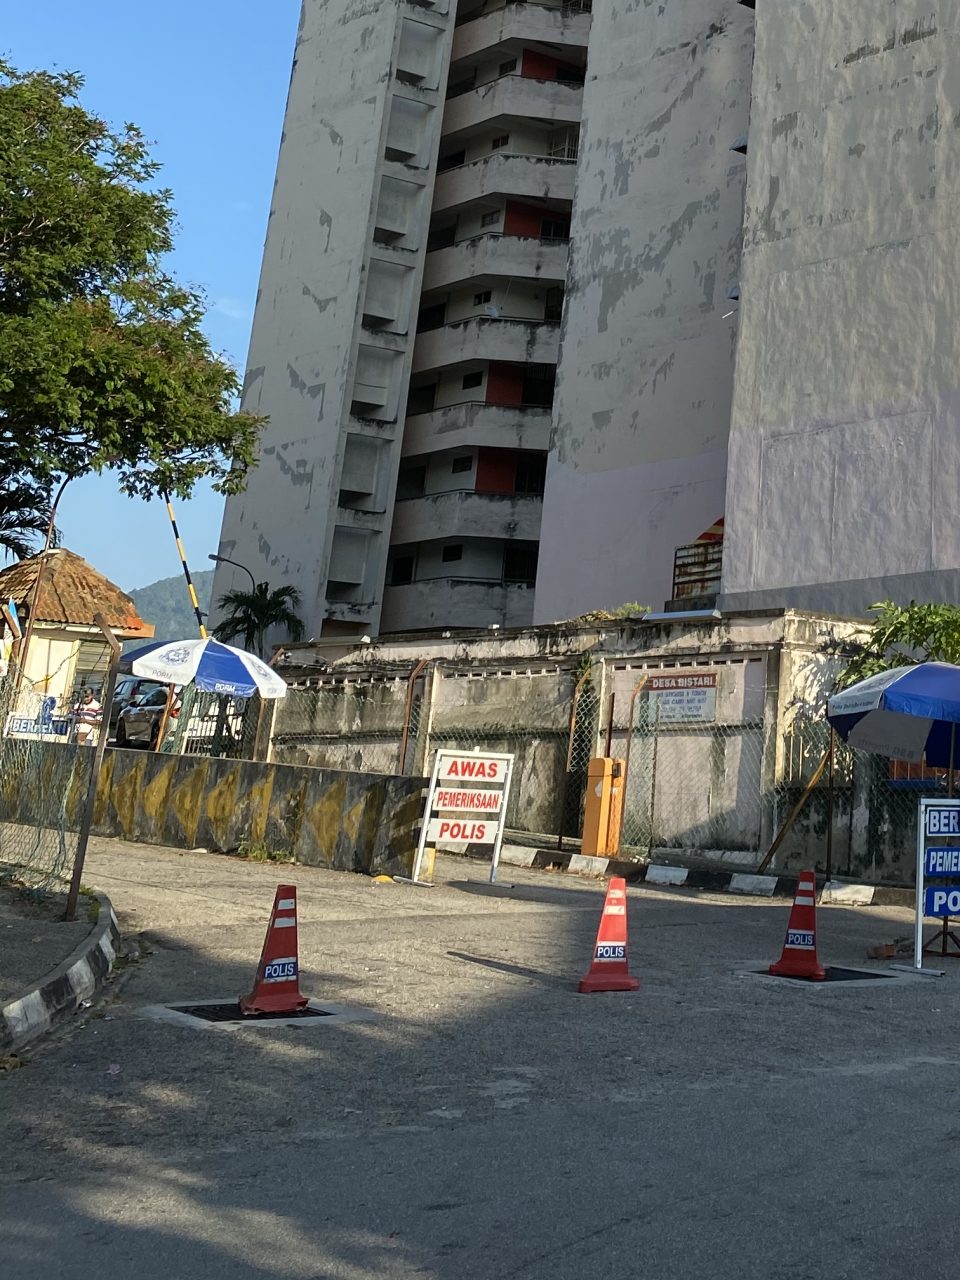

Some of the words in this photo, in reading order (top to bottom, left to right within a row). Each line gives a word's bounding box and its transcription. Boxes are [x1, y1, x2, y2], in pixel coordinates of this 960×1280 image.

[652, 678, 676, 688] DESA
[677, 676, 713, 687] BISTARI
[447, 760, 498, 778] AWAS
[437, 791, 500, 809] PEMERIKSAAN
[439, 822, 486, 839] POLIS
[788, 934, 813, 945] POLIS
[597, 946, 624, 957] POLIS
[265, 963, 295, 978] POLIS
